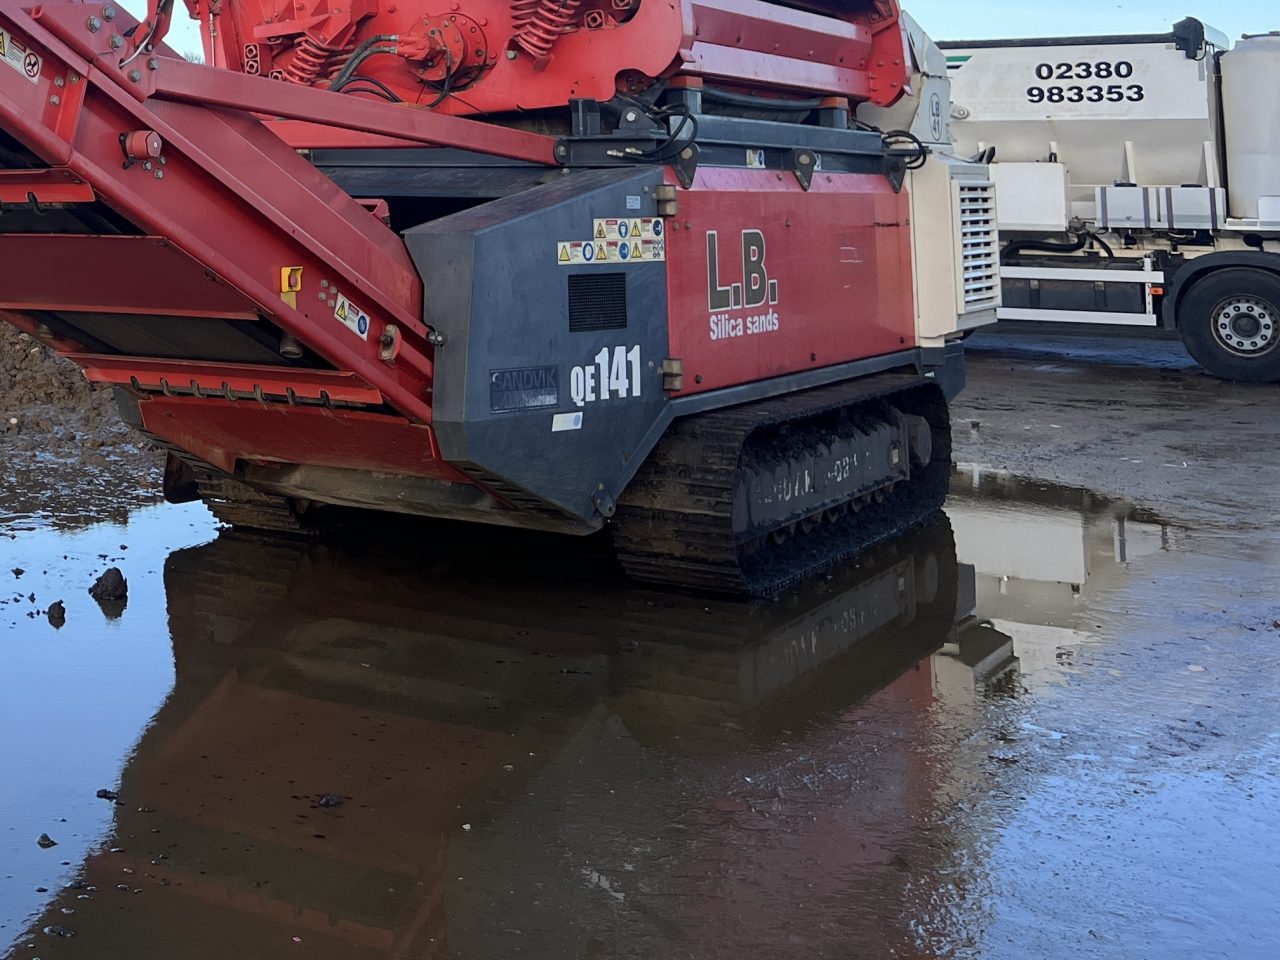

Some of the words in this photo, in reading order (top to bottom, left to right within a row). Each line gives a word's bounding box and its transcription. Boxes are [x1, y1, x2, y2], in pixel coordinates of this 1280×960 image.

[1035, 61, 1133, 80] 02380
[1026, 84, 1145, 103] 983353
[931, 100, 940, 117] LB
[706, 229, 778, 312] L.B.
[709, 314, 744, 340] Silica
[746, 307, 779, 335] sands
[492, 368, 556, 391] SANDVIK
[570, 344, 641, 407] QE141
